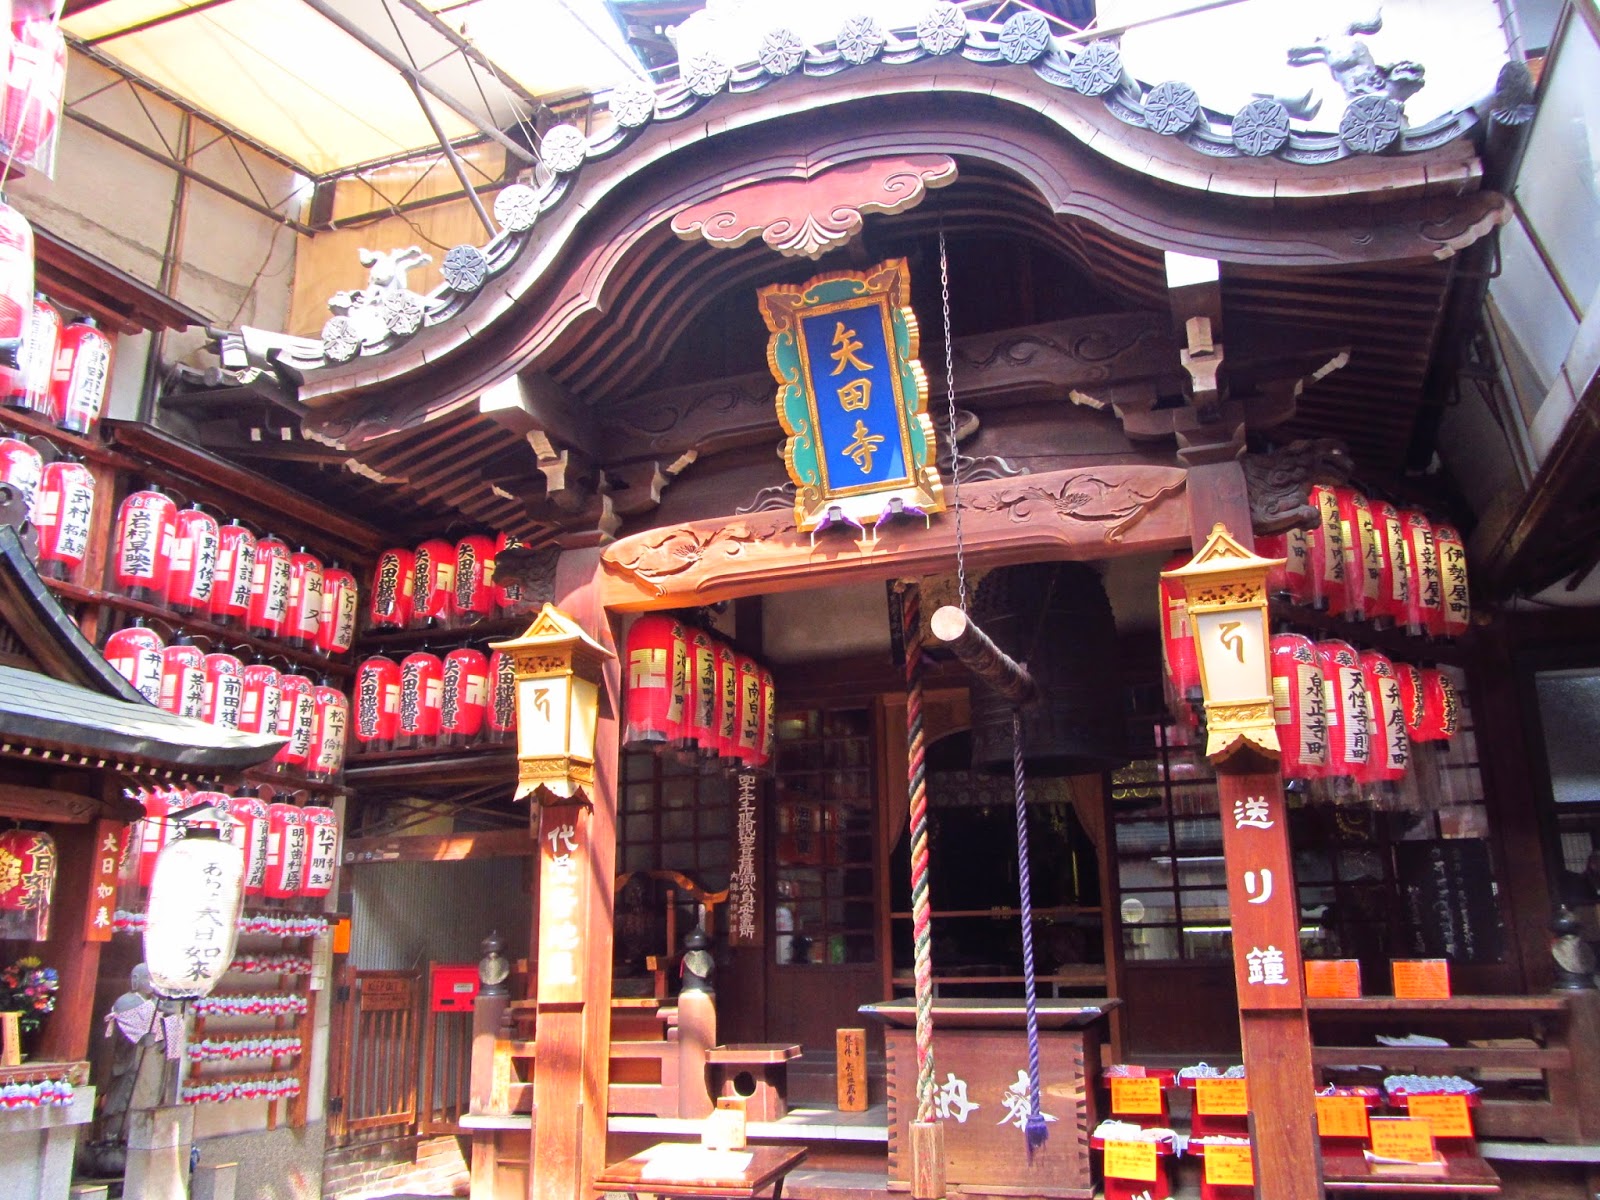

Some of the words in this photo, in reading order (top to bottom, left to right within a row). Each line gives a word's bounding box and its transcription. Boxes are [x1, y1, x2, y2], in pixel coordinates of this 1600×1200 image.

[829, 320, 886, 475] 矢田寺
[1444, 546, 1468, 621] 伊勢屋町
[1306, 672, 1327, 763] 泉正寺町
[1348, 671, 1370, 764] 天性寺前町
[93, 832, 120, 929] 大日如来
